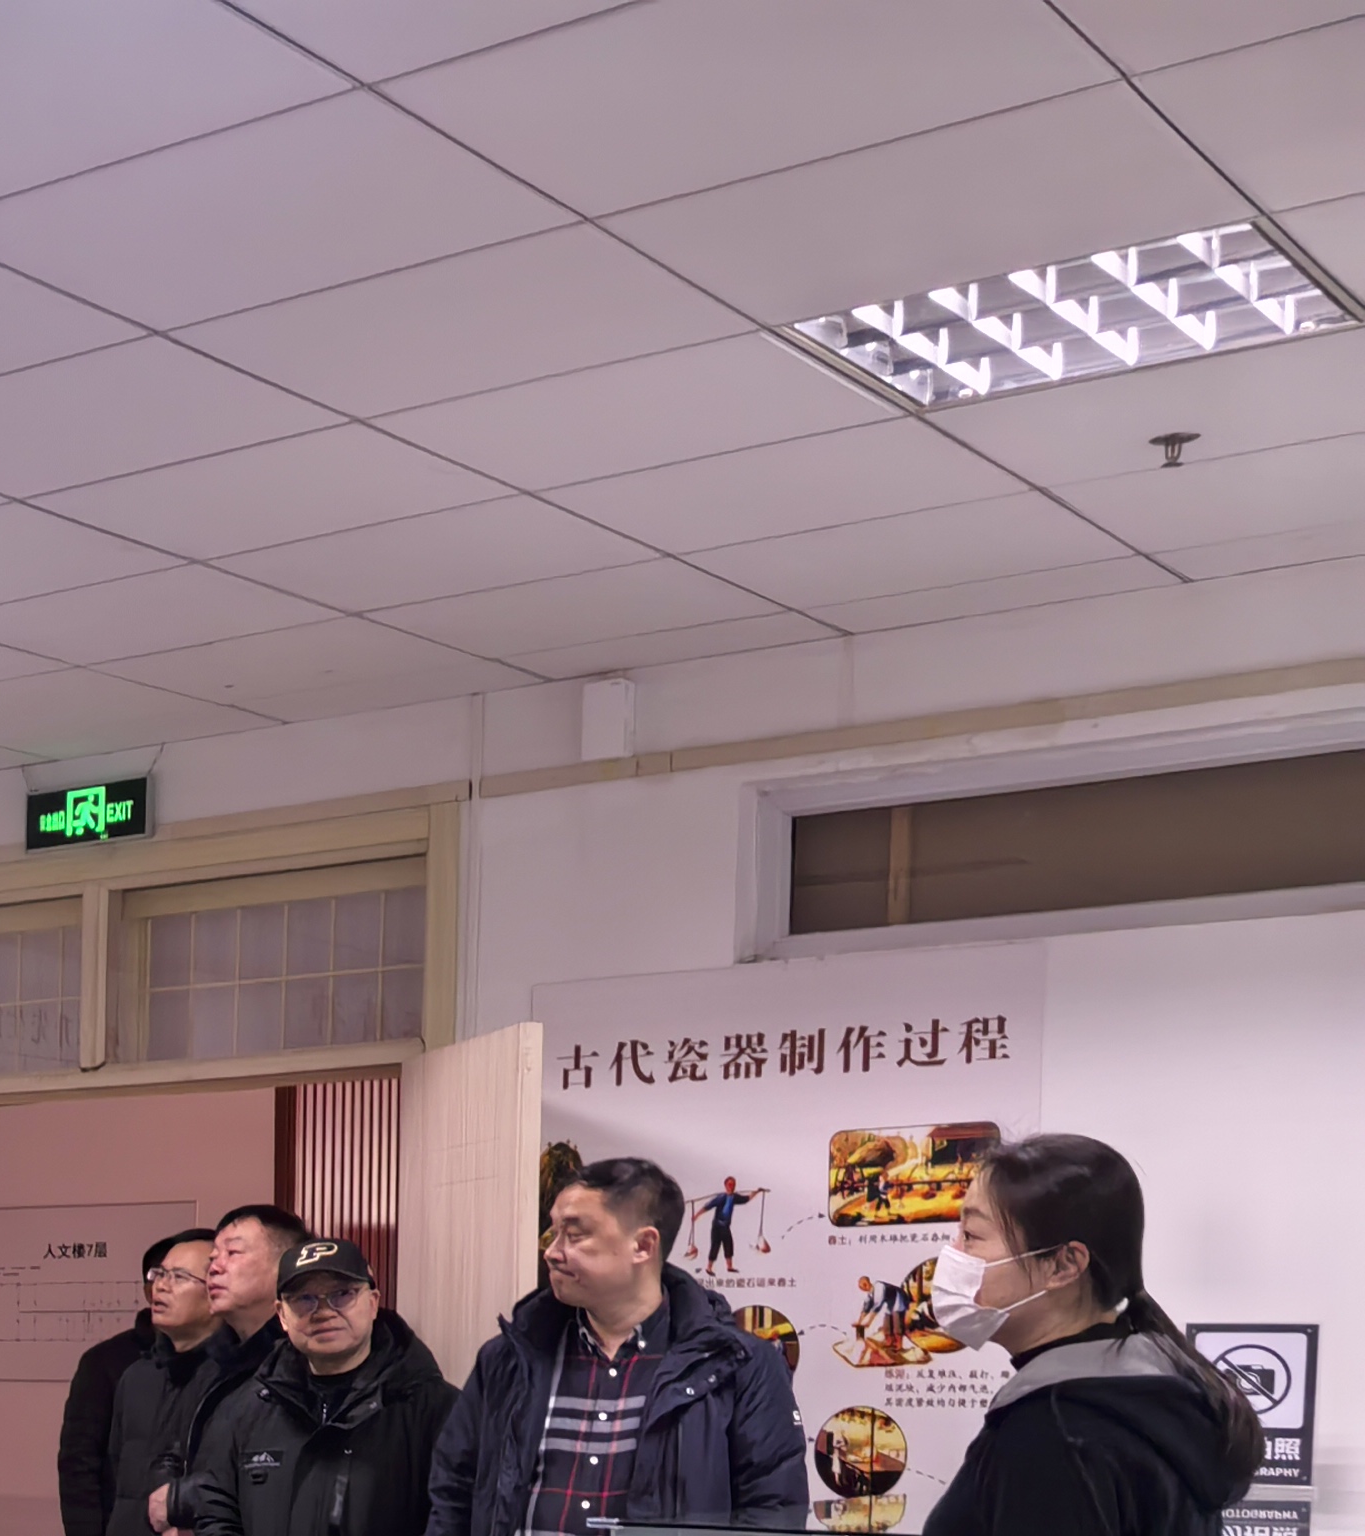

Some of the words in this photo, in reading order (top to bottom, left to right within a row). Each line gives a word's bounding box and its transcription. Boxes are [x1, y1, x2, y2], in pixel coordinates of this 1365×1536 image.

[106, 800, 134, 824] EXIT
[557, 1015, 1011, 1091] 古代瓷器制作过程
[296, 1242, 338, 1267] P
